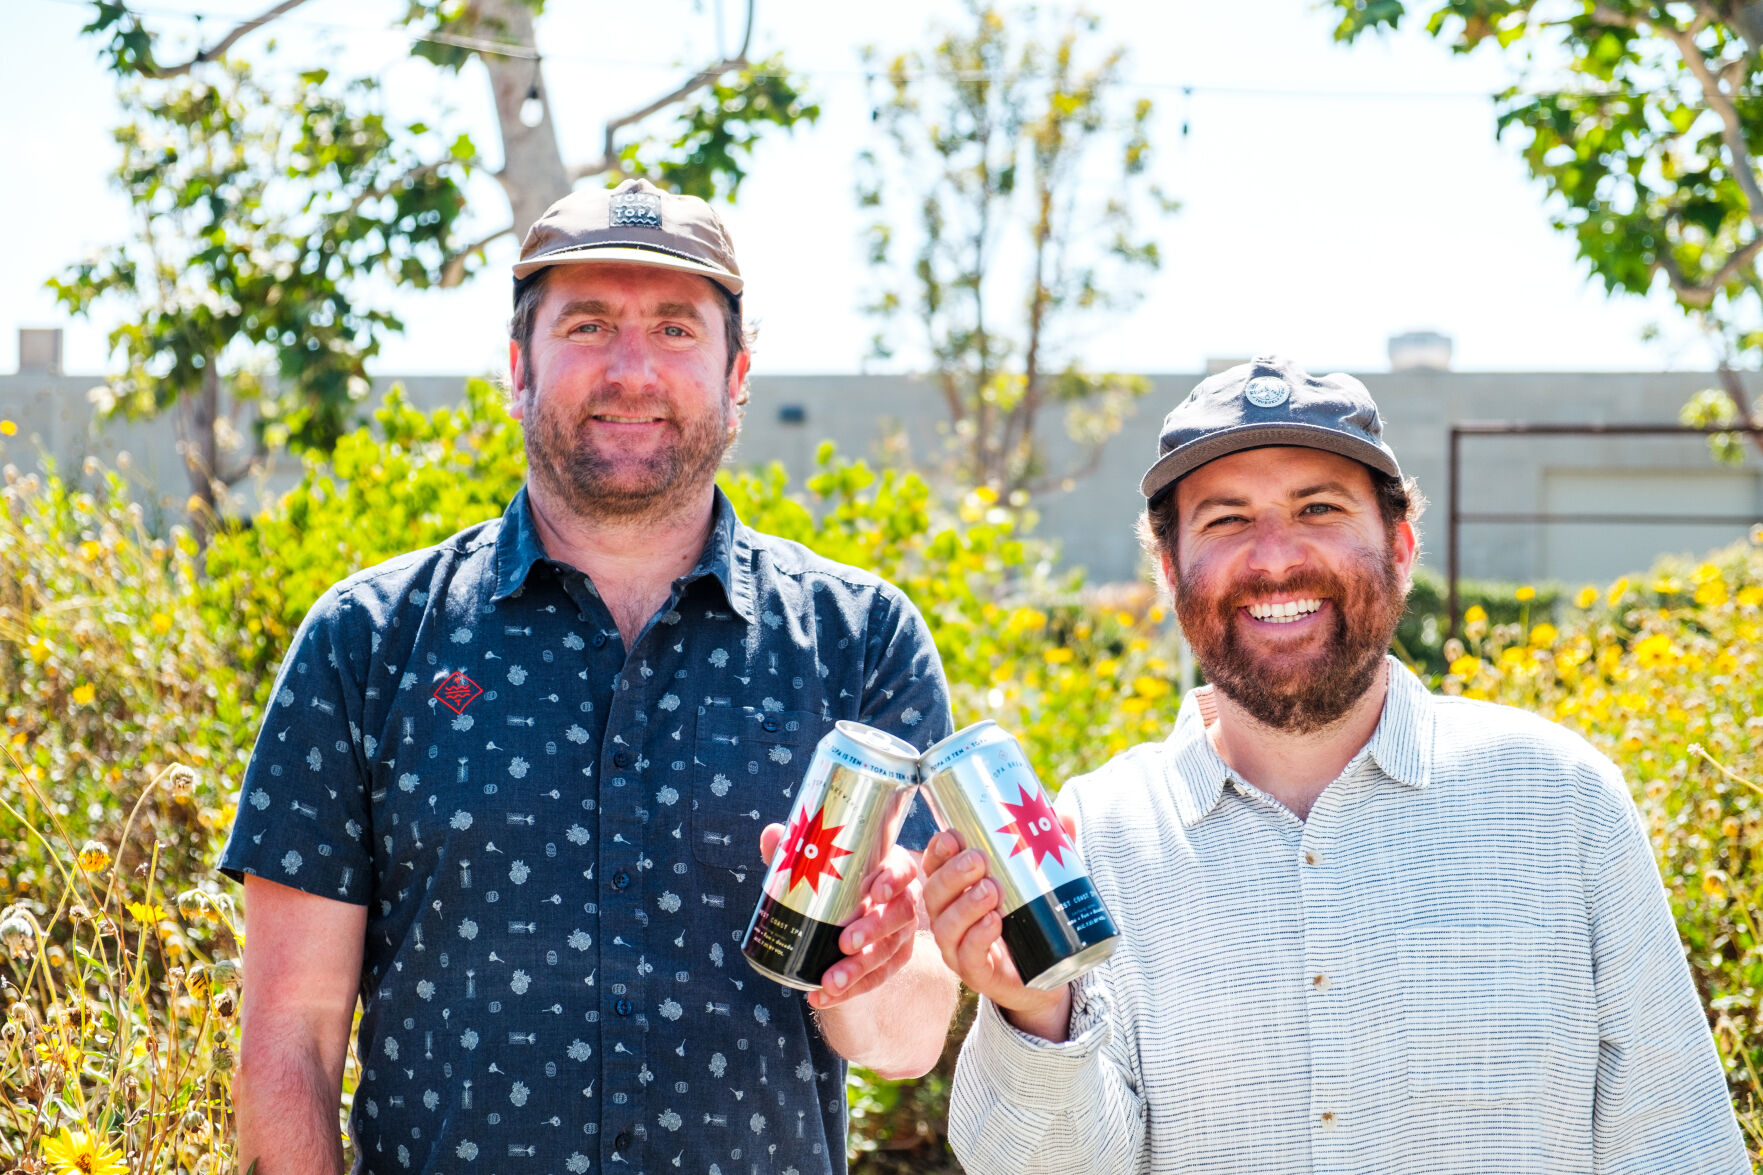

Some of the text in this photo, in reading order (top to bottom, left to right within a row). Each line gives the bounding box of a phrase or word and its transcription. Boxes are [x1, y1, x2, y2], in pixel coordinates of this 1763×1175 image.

[615, 208, 657, 218] TOPA
[849, 756, 862, 767] TEN
[870, 765, 887, 776] TOPA
[895, 772, 906, 781] TEN
[1027, 816, 1052, 837] 10
[795, 837, 818, 859] 10
[770, 917, 788, 930] COAST
[790, 927, 803, 937] IPA
